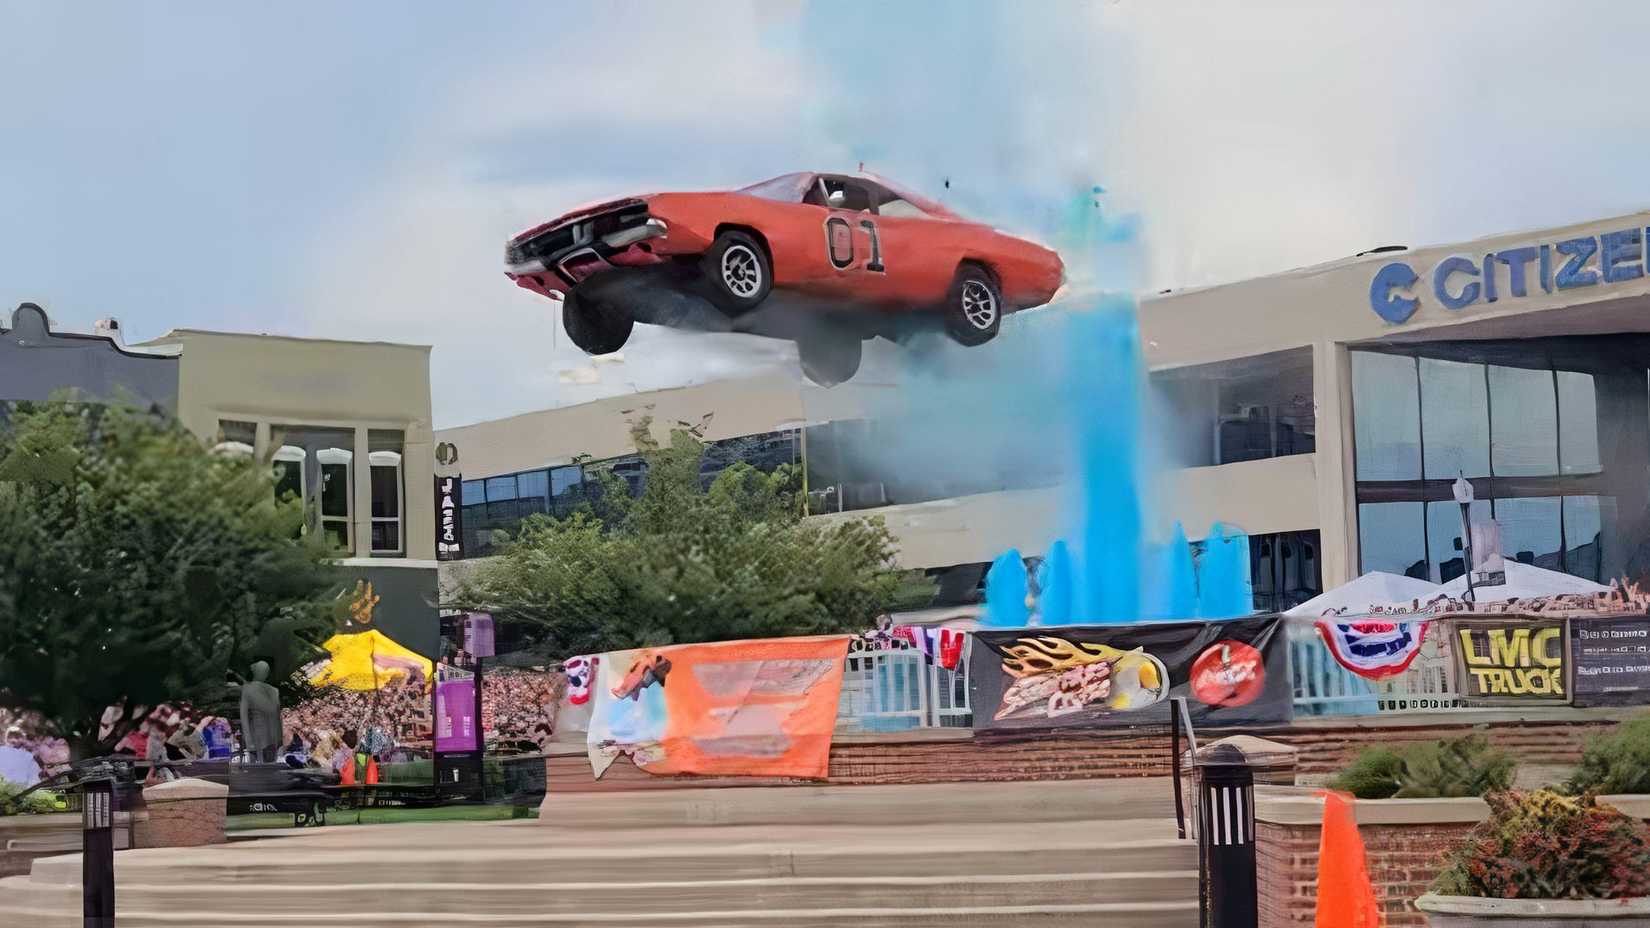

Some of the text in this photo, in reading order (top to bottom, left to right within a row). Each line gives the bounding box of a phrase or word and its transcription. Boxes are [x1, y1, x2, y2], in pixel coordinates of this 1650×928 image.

[825, 215, 885, 273] 01
[1433, 226, 1650, 310] CITIZE
[1459, 627, 1562, 668] LMC
